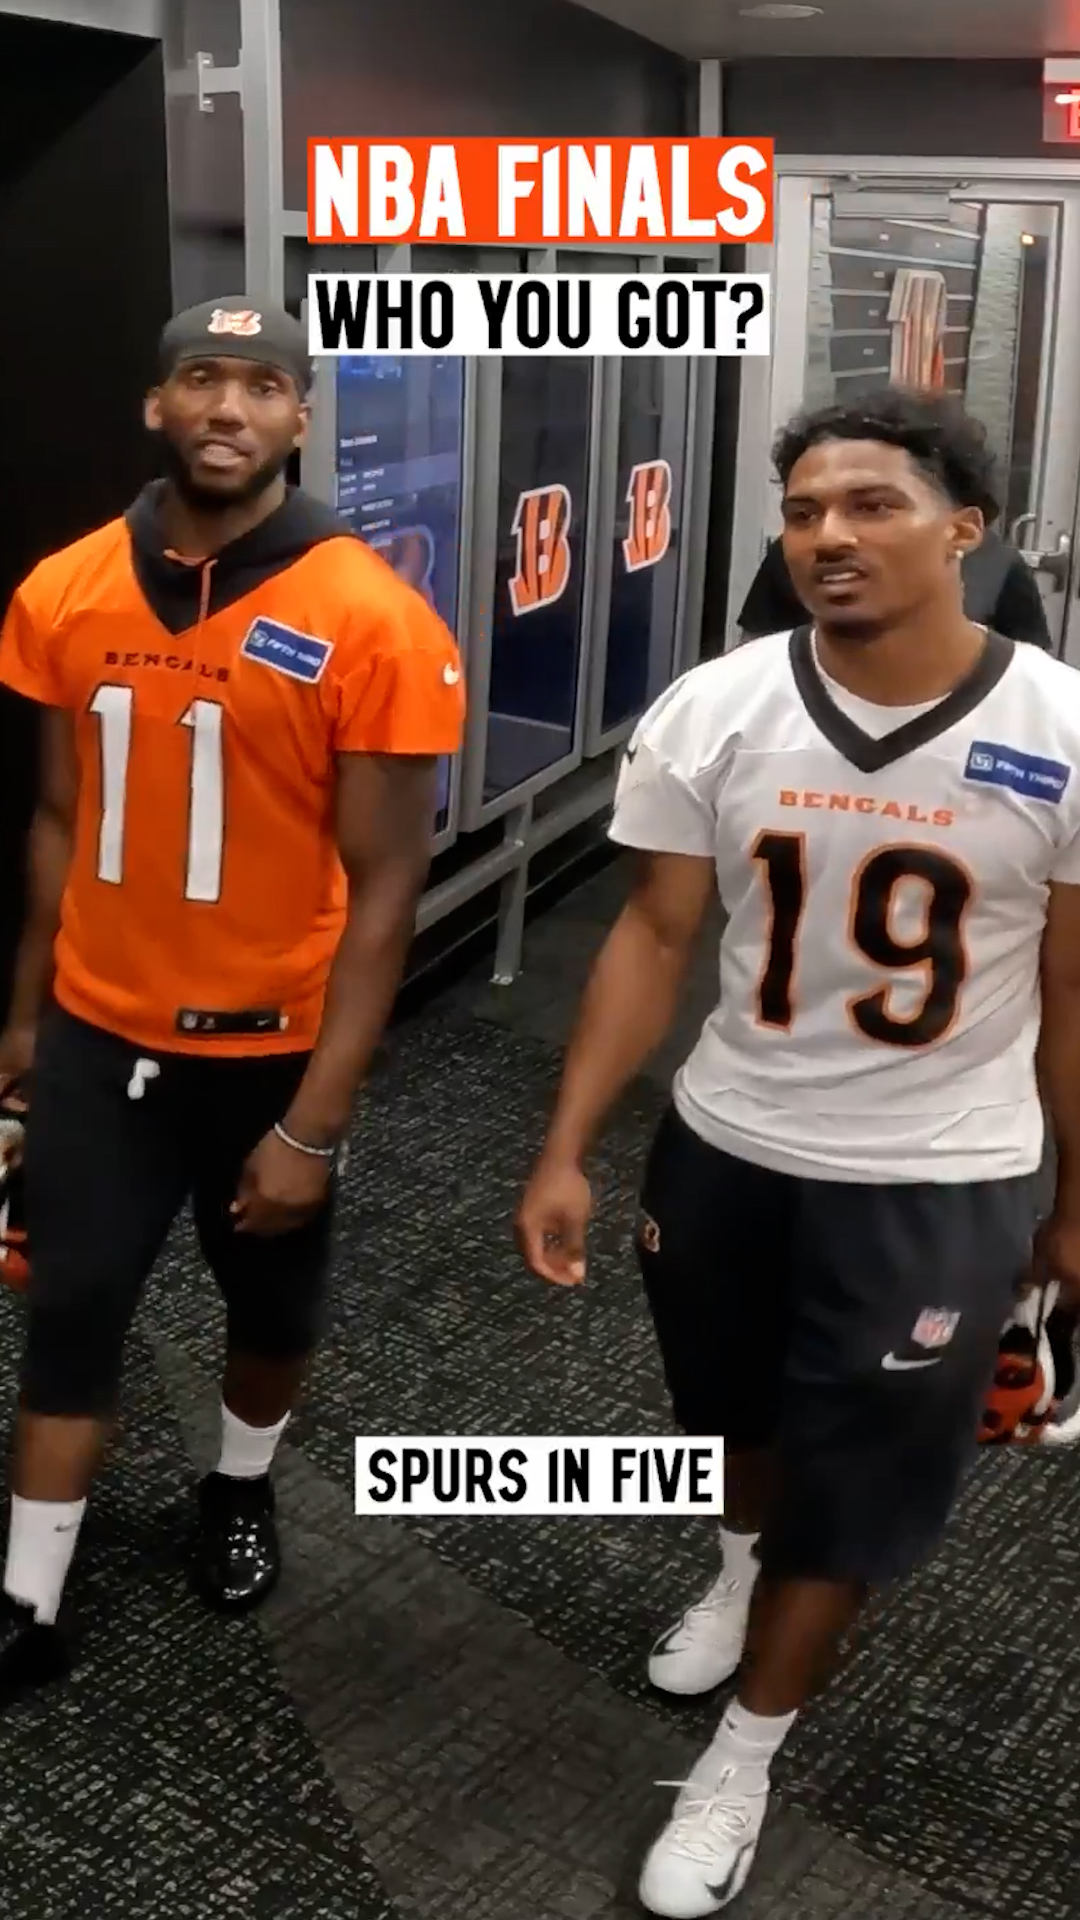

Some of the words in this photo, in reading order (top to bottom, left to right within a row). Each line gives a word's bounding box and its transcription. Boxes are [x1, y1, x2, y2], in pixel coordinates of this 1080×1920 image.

[104, 652, 230, 682] BENGALS
[89, 682, 226, 904] 11
[779, 790, 955, 826] BENGALS
[749, 827, 976, 1052] 19
